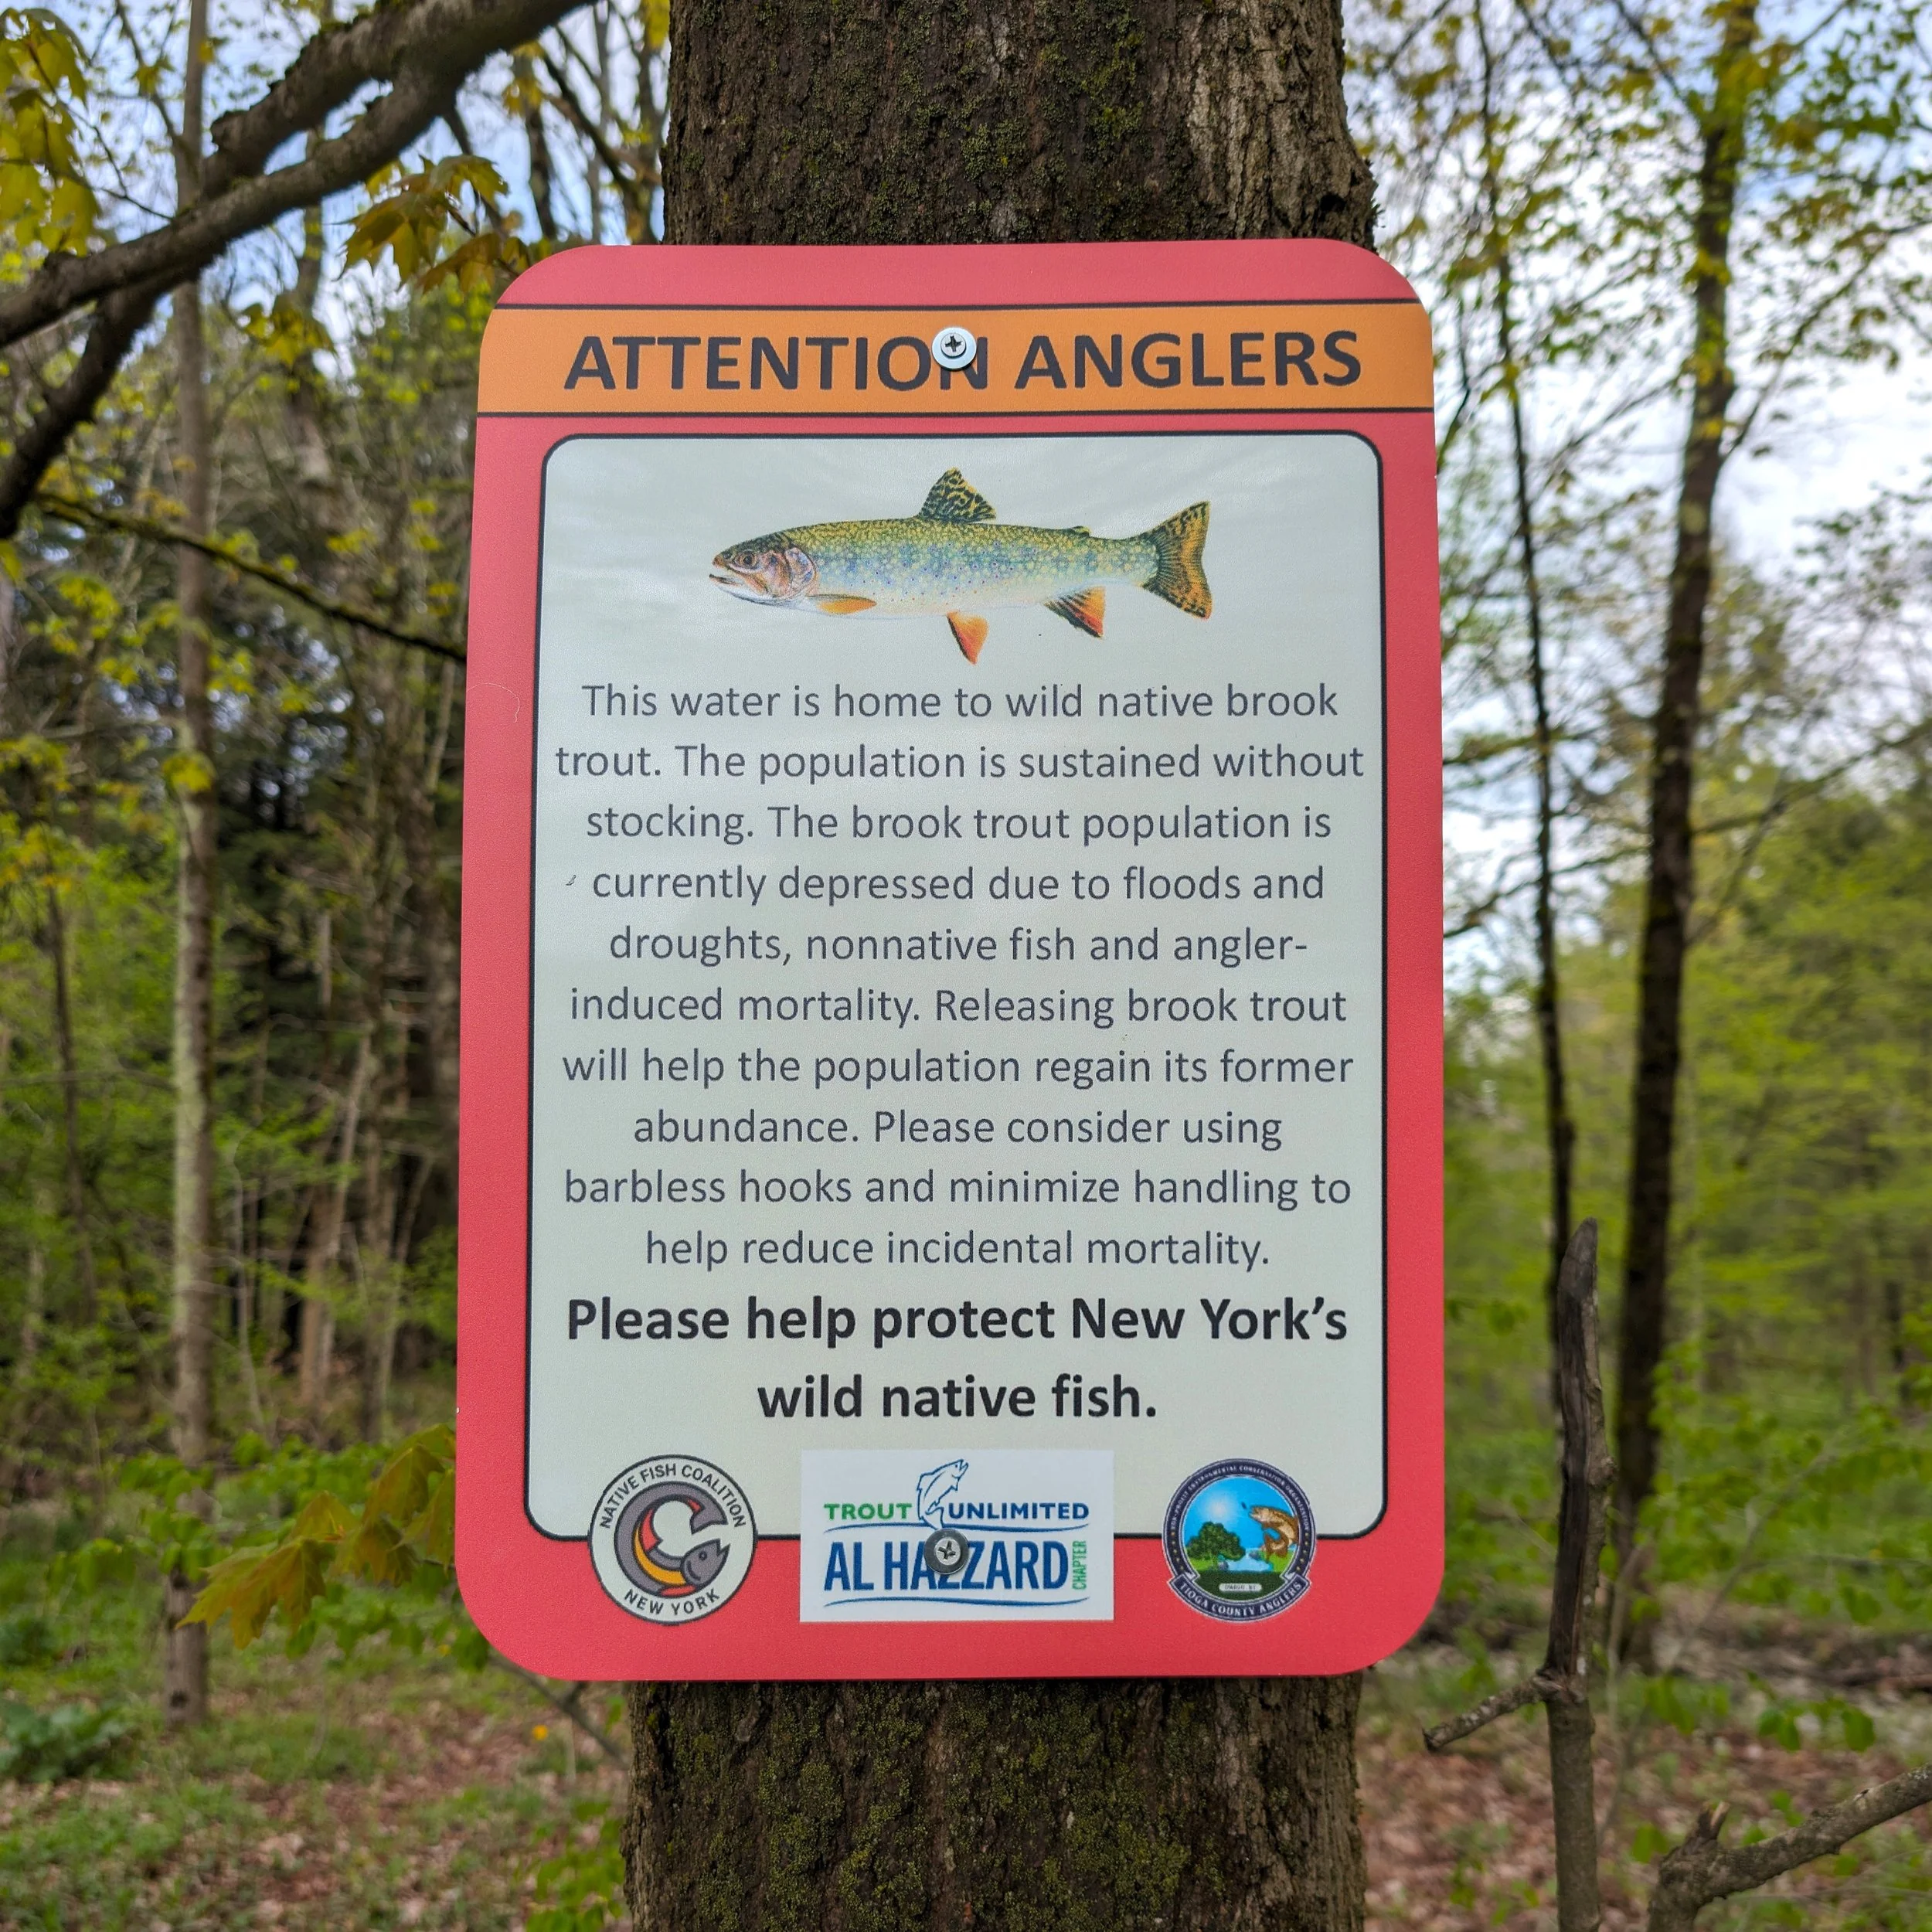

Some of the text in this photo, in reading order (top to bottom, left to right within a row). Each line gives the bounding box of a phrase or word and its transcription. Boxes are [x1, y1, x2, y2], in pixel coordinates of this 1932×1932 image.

[563, 330, 1362, 391] ATTENTION ANGLERS
[581, 682, 1338, 718] This water is home to wild native brook
[555, 743, 1364, 785] trout. The population is sustained without
[587, 803, 1332, 848] stocking. The brook trout population is
[593, 865, 1324, 907] currently depressed due to floods and
[610, 924, 1308, 969] droughts, nonnative fish and angler-
[571, 985, 1347, 1030] induced mortality. Releasing brook trout
[562, 1047, 1354, 1090] will help the population regain its former
[634, 1108, 1282, 1152] abundance. Please consider using
[566, 1168, 1351, 1212] barbless hooks and minimize handling to
[647, 1229, 1269, 1274] help reduce incidental mortality.
[568, 1295, 730, 1341] Please
[747, 1294, 856, 1350] help
[873, 1300, 1056, 1349] protect
[1072, 1297, 1185, 1340] New
[757, 1372, 1156, 1419] wild native fish.
[600, 1463, 747, 1529] NATIVE FISH COALITION
[824, 1502, 1090, 1520] TROUT UNLIMITED
[824, 1541, 874, 1591] AL
[1072, 1539, 1087, 1590] CHAPTER
[624, 1588, 720, 1615] NEW YORK
[1180, 1582, 1302, 1616] TIOGA COUNTY ANGLERS
